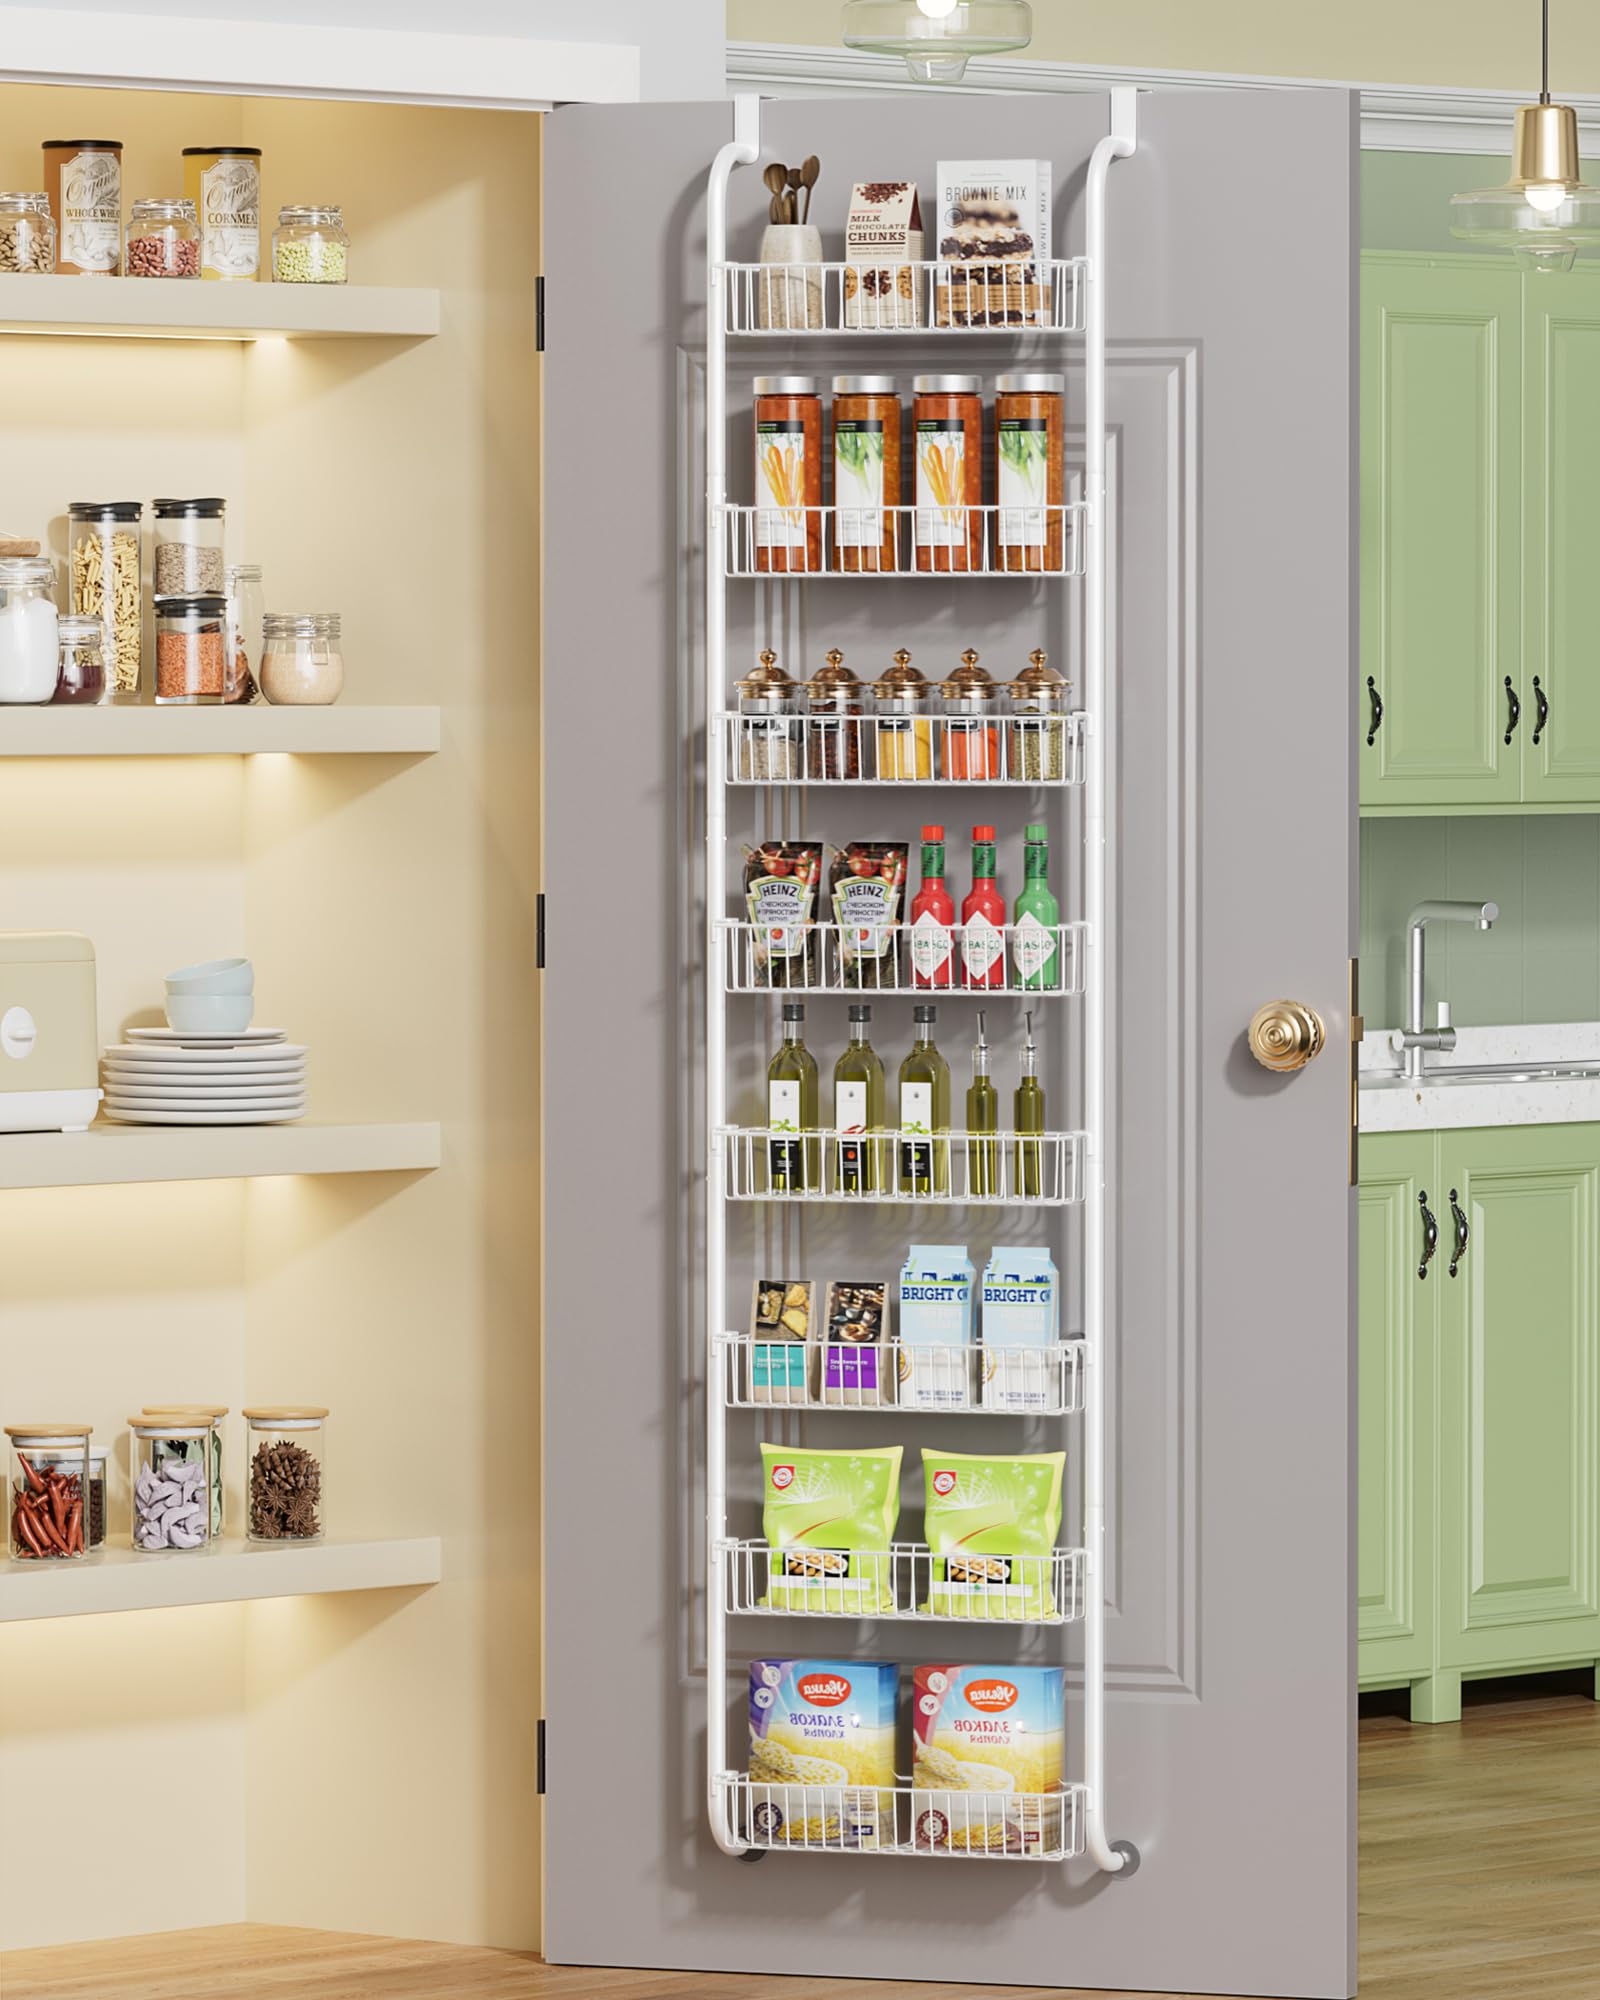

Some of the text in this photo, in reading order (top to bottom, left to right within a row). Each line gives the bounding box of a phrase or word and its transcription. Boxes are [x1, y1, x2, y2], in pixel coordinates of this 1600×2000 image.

[945, 185, 1027, 202] BROWNIE MIX
[65, 208, 99, 218] WHOLE
[850, 215, 881, 223] MILK
[848, 223, 907, 231] CHOCOLATE
[848, 231, 907, 242] CHUNKS
[762, 884, 798, 897] HEINZ
[847, 884, 884, 898] HEINZ
[901, 1286, 955, 1301] BRIGHT
[984, 1288, 1037, 1303] BRIGHT
